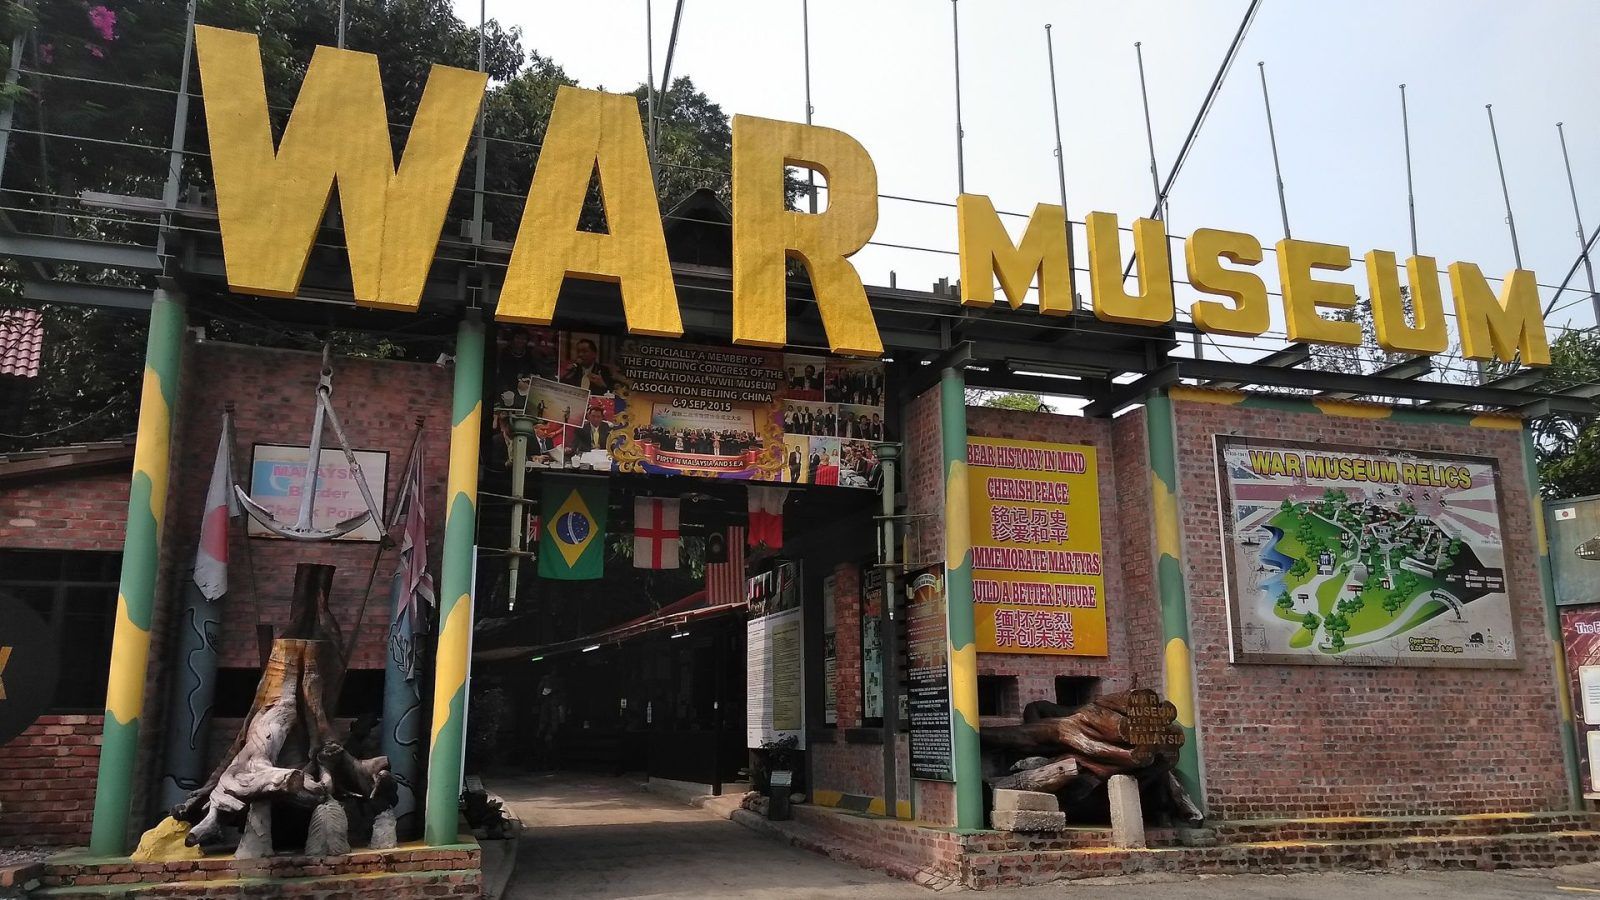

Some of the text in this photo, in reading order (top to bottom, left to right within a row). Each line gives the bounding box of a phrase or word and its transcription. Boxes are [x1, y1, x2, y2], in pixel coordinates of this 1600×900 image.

[193, 24, 1552, 367] WAR MUSEUM
[640, 345, 764, 365] OFFICIALLY A MEMBER OF
[623, 356, 784, 379] THE FOUNDING CONGRESS OF THE
[626, 369, 776, 390] INTERNATIONAL WWII MUSEUM
[631, 382, 699, 396] ASSOCIATION
[700, 388, 738, 400] BEIJING
[672, 398, 732, 412] 6-9 SEP 2015
[656, 455, 674, 463] FIRST
[681, 459, 713, 467] MALAYSIA
[967, 444, 1086, 473] BEAR HISTORY IN MIND
[1248, 450, 1473, 489] WAR MUSEUM RELICS
[288, 486, 350, 498] Bder
[987, 477, 1070, 504] CHERISH PEACE
[990, 505, 1067, 527] 铭记历史
[991, 523, 1068, 544] 珍爱和平
[1049, 550, 1101, 575] MARTYRS
[972, 580, 1097, 608] UILD A BETTER FUTURE
[994, 609, 1073, 631] 缅怀先烈
[1575, 622, 1594, 634] The
[996, 628, 1074, 648] 开创未来
[1409, 637, 1424, 646] Open
[1130, 694, 1157, 705] WAR
[1128, 706, 1174, 717] MUSEUM
[1129, 732, 1184, 745] MALAYSIA
